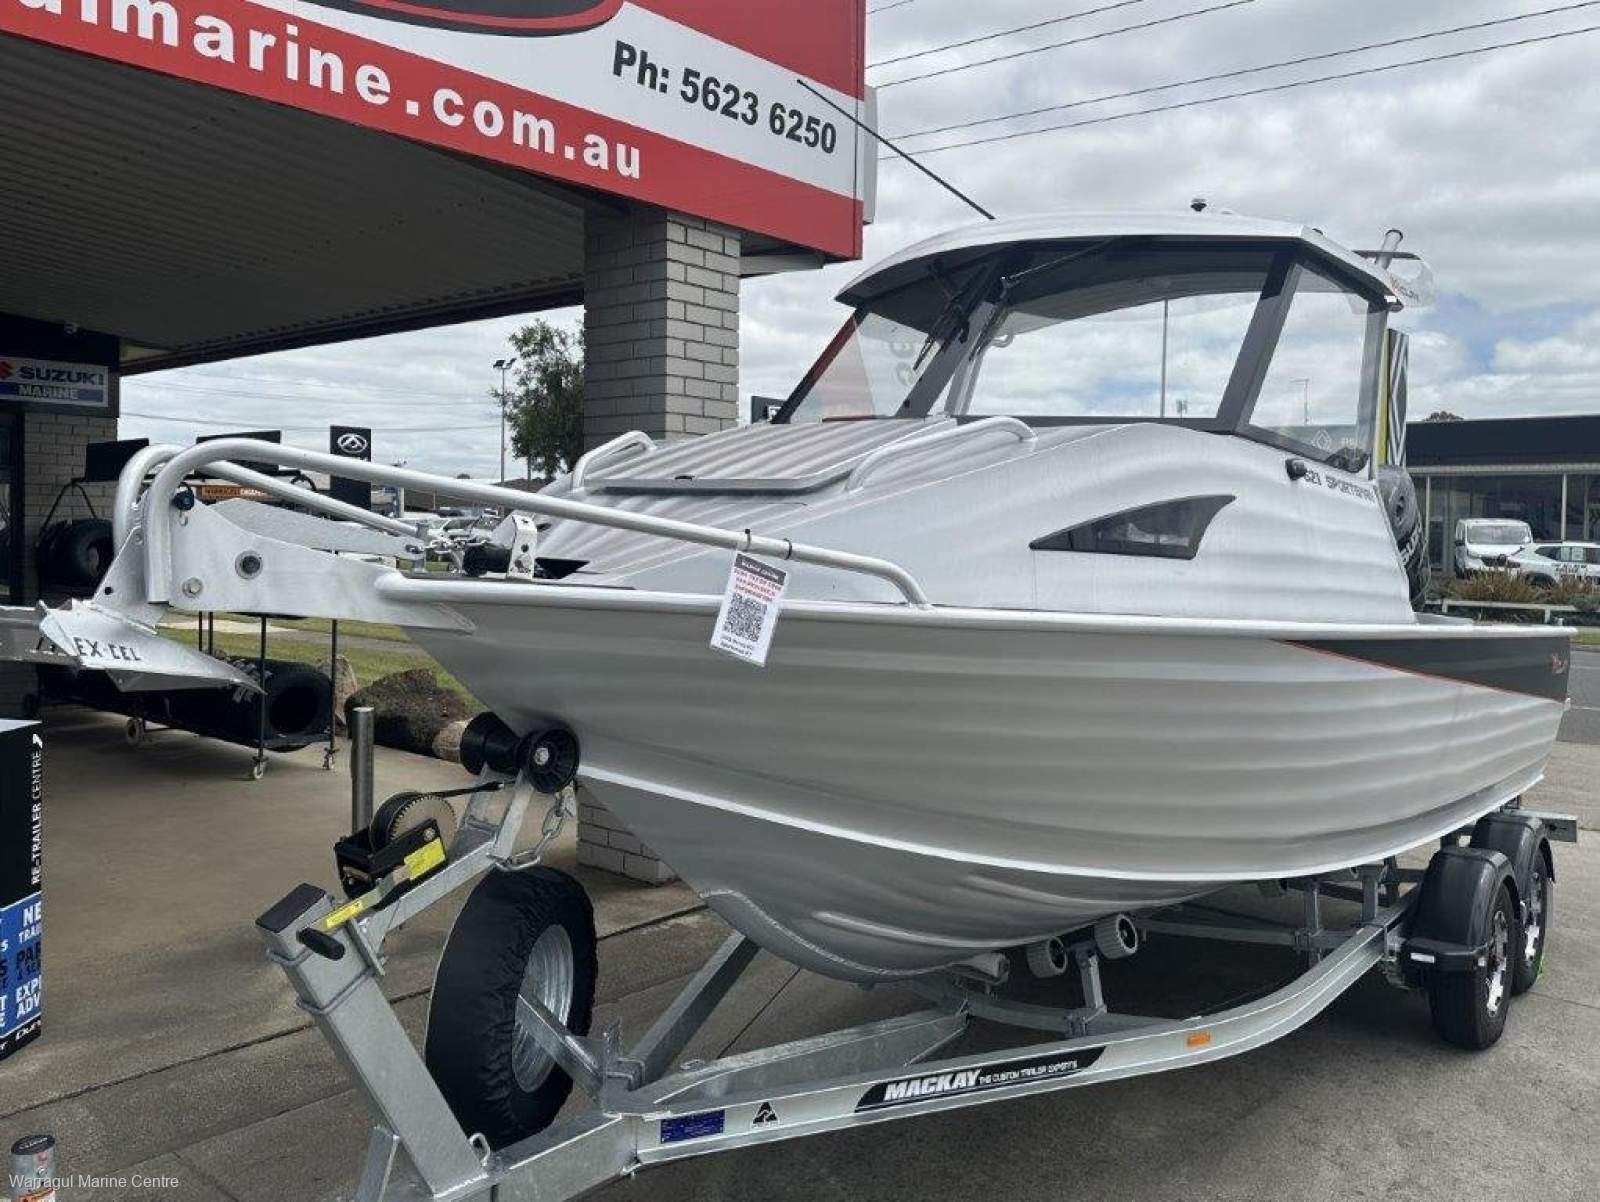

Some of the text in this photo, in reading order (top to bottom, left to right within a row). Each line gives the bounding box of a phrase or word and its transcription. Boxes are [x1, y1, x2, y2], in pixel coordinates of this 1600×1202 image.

[18, 0, 641, 179] marine.com.au
[612, 39, 842, 154] Ph: 5623 6250
[17, 383, 80, 400] MARINE
[18, 365, 105, 386] SUZUKI
[31, 749, 42, 801] CENTRE
[884, 1068, 982, 1102] MACKAY
